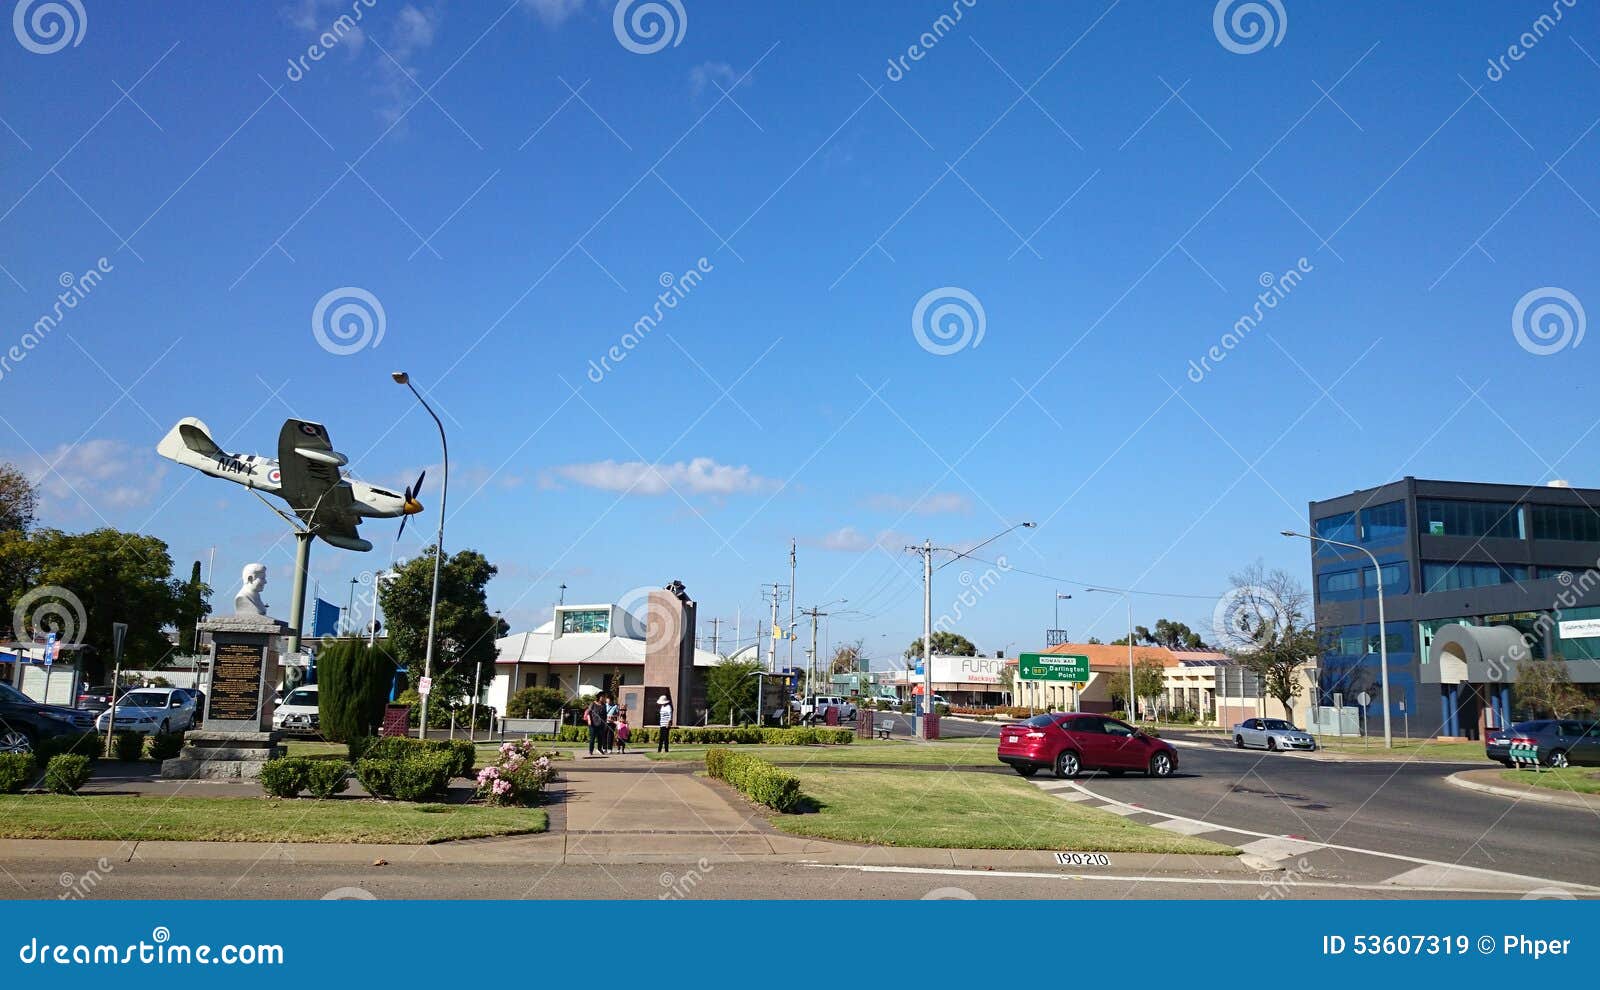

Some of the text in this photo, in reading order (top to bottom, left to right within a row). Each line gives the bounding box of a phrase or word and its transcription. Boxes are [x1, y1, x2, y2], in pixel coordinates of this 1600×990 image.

[216, 457, 258, 476] NAVY
[1049, 665, 1085, 673] Darlington
[968, 675, 997, 683] Mackays
[1057, 853, 1109, 866] 190210
